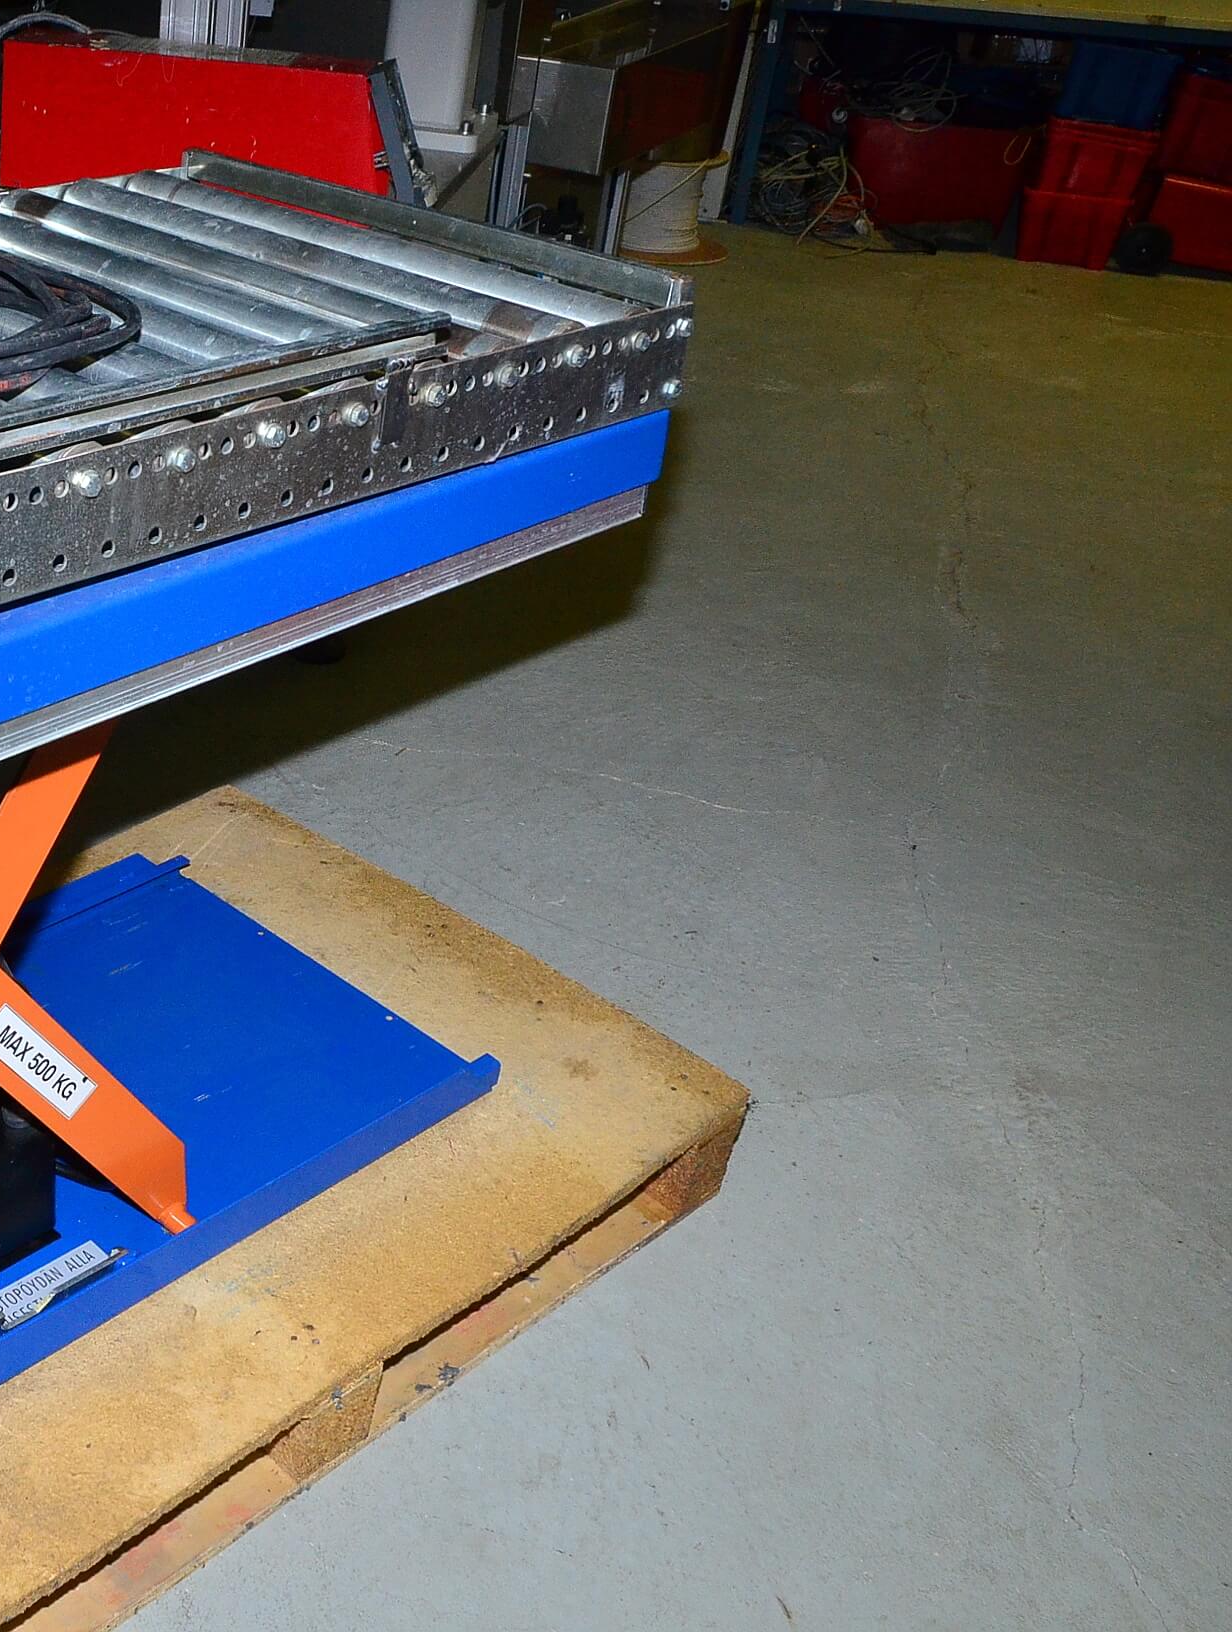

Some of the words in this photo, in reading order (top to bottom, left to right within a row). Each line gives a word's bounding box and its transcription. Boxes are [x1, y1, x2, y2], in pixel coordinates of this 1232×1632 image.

[28, 1053, 57, 1081] 500
[52, 1073, 77, 1100] KG
[64, 1250, 95, 1272] ALLA
